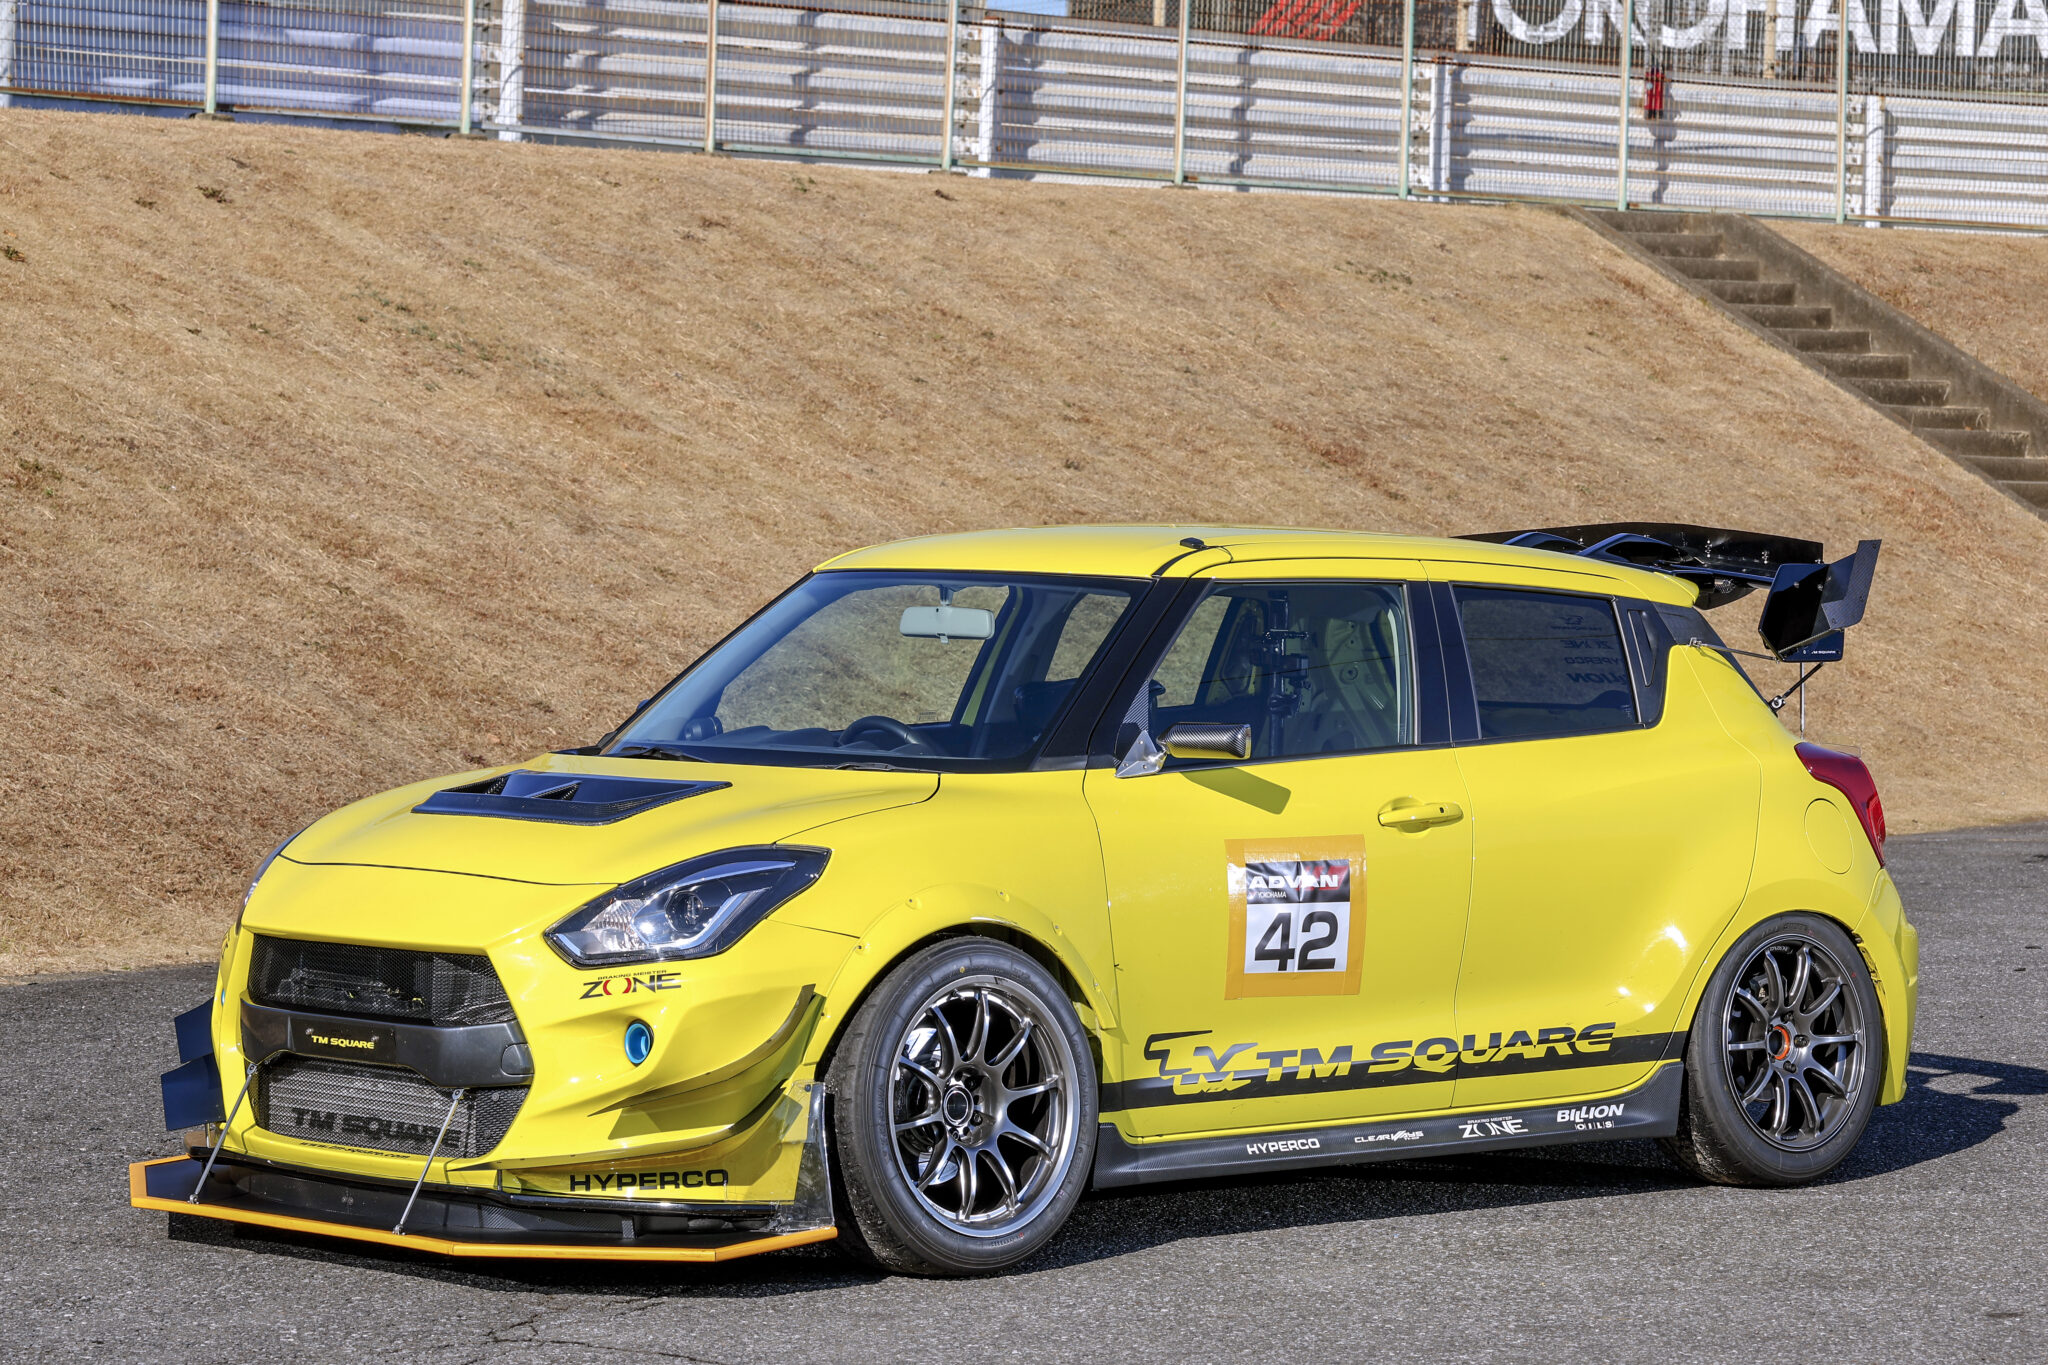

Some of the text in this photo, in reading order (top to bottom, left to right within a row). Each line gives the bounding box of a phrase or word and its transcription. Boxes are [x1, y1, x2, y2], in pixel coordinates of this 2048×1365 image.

[1249, 874, 1338, 889] ADVAN
[1255, 911, 1338, 971] 42
[597, 969, 667, 981] BRAKING MEISTER
[579, 972, 681, 1000] ZONE
[311, 1035, 375, 1050] TM SQUARE
[1256, 1045, 1353, 1082] TM
[1367, 1022, 1616, 1073] SQUARE
[1556, 1103, 1625, 1123] BILLION
[292, 1107, 462, 1149] TM SQUARE
[1458, 1119, 1528, 1138] ZONE
[1246, 1138, 1320, 1155] HYPERCO
[569, 1169, 729, 1192] HYPERCO
